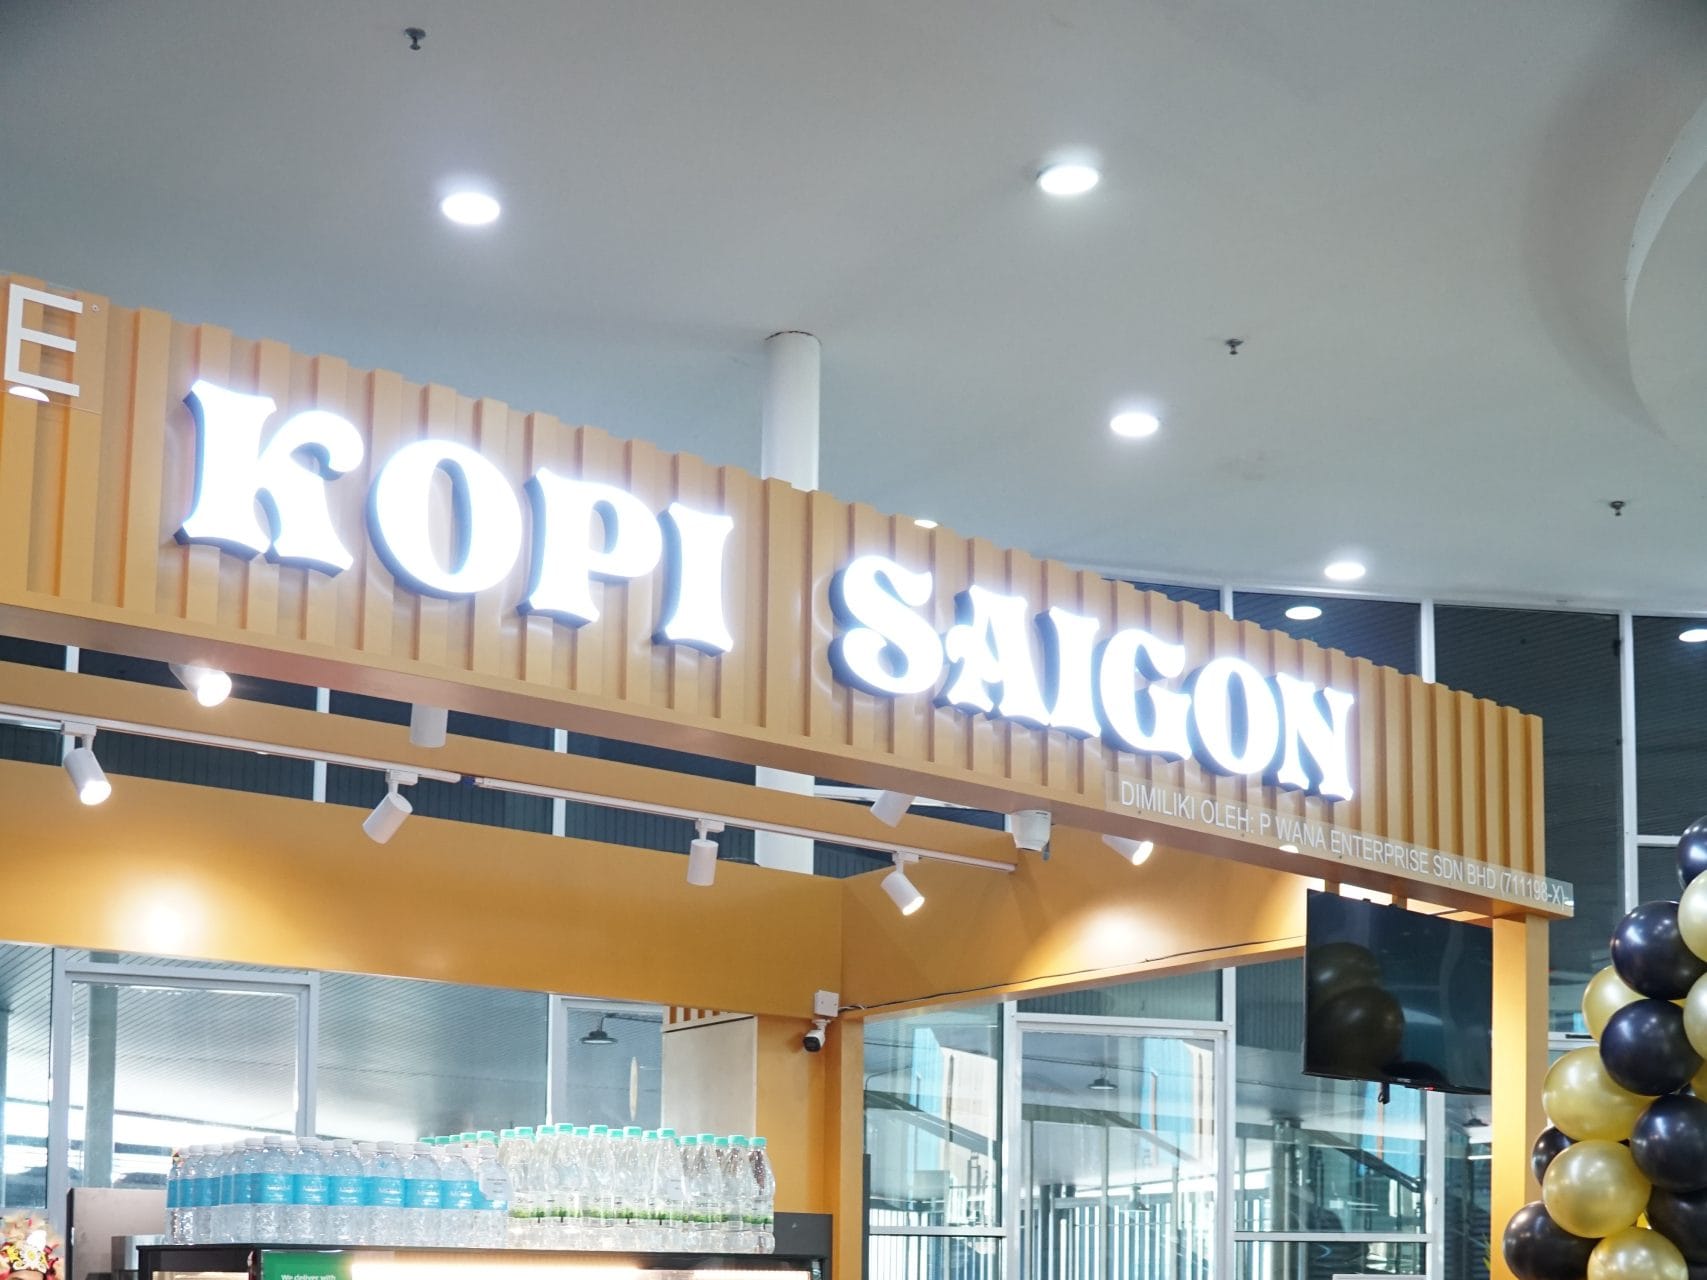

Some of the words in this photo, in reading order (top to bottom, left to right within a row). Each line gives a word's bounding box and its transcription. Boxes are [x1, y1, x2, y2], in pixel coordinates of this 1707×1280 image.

[4, 283, 83, 397] E
[172, 378, 735, 657] KOPI
[827, 553, 1355, 802] SAIGON
[1121, 781, 1195, 820] DIMILIKI
[1200, 799, 1254, 834] OLEH:
[1260, 812, 1271, 836] P
[1275, 816, 1327, 850] WANA
[1331, 829, 1429, 874] ENTERPRISE
[1433, 854, 1464, 882] SDN
[1467, 863, 1497, 890] BHD
[294, 1273, 319, 1280] deliver
[320, 1273, 336, 1280] with
